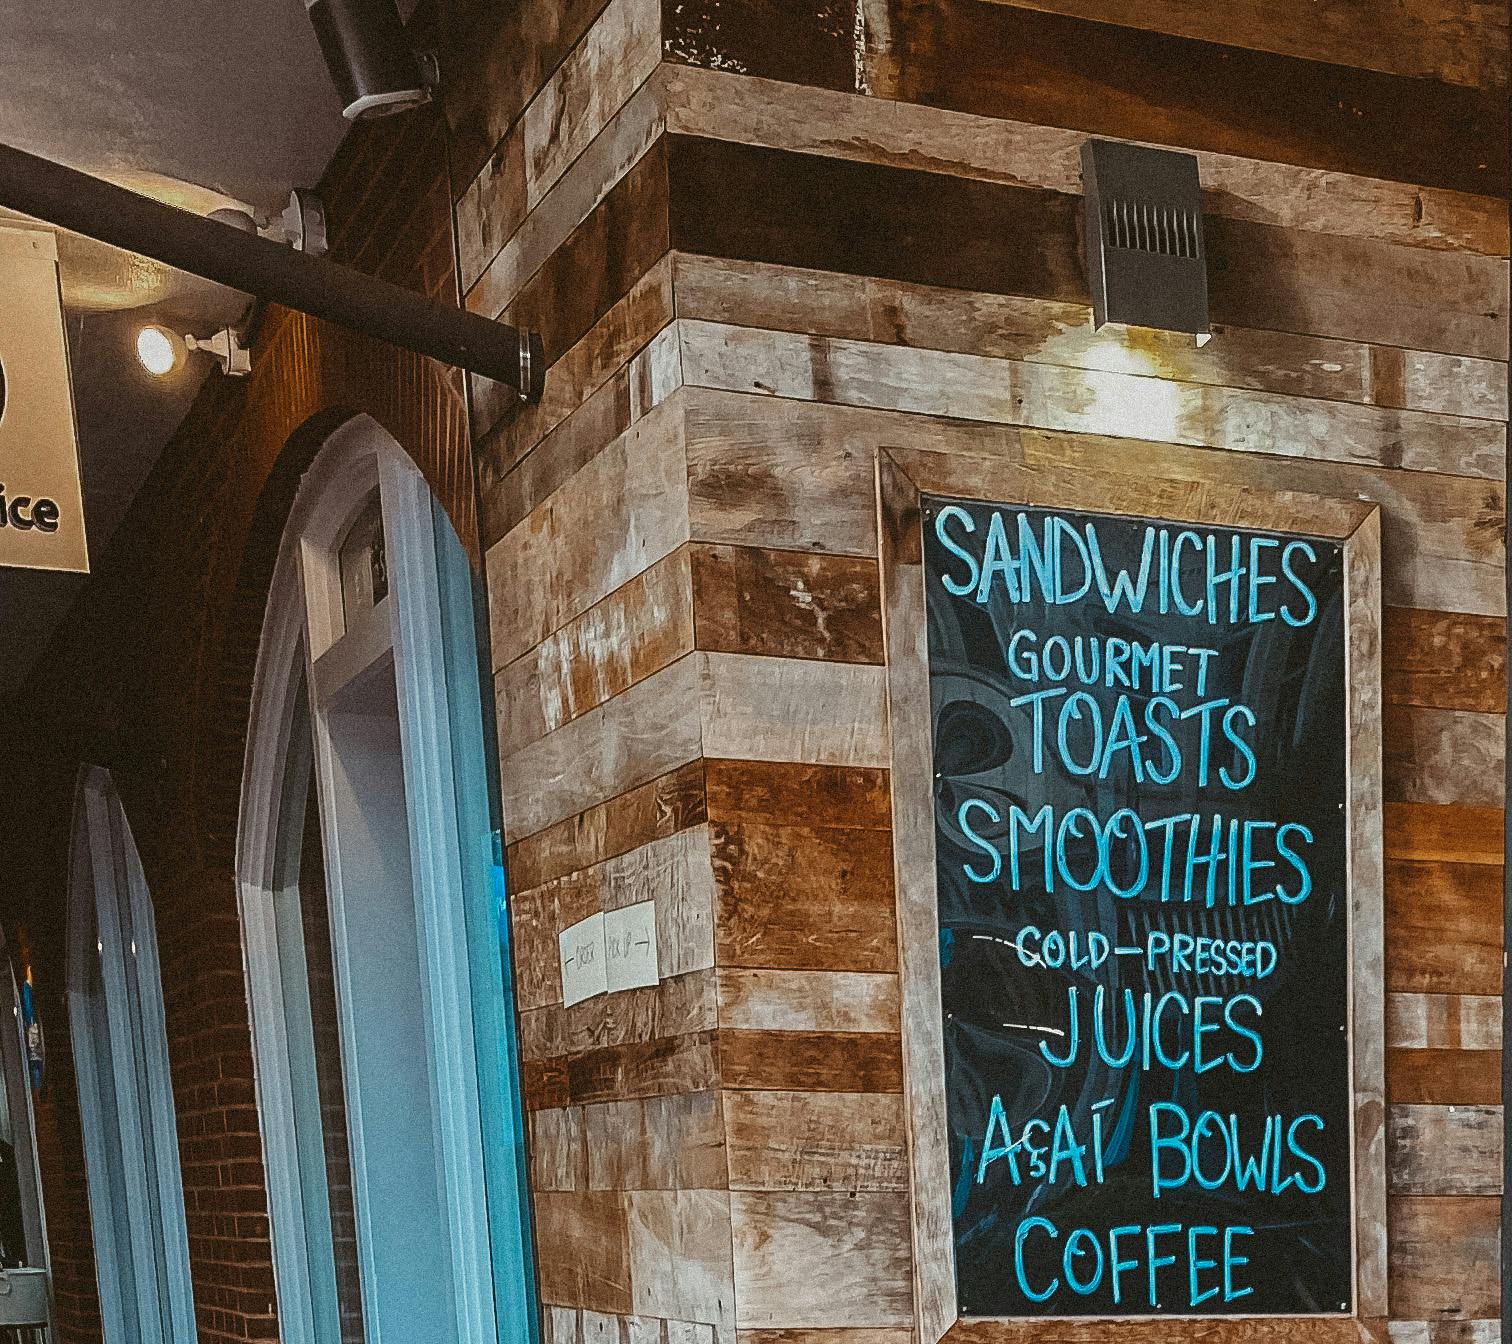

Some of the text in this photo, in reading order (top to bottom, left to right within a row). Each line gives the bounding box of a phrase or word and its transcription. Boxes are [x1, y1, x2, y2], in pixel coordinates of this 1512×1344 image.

[935, 505, 1318, 628] SANDWICHES
[1008, 629, 1219, 698] GOURMET
[1010, 686, 1257, 790] TOASTS
[958, 799, 1314, 909] SMOOTHIES
[1015, 925, 1278, 979] COLD-PRESSED
[1038, 985, 1263, 1075] JUICES
[1149, 1101, 1327, 1199] BOWLS
[1014, 1215, 1256, 1308] COFFEE
